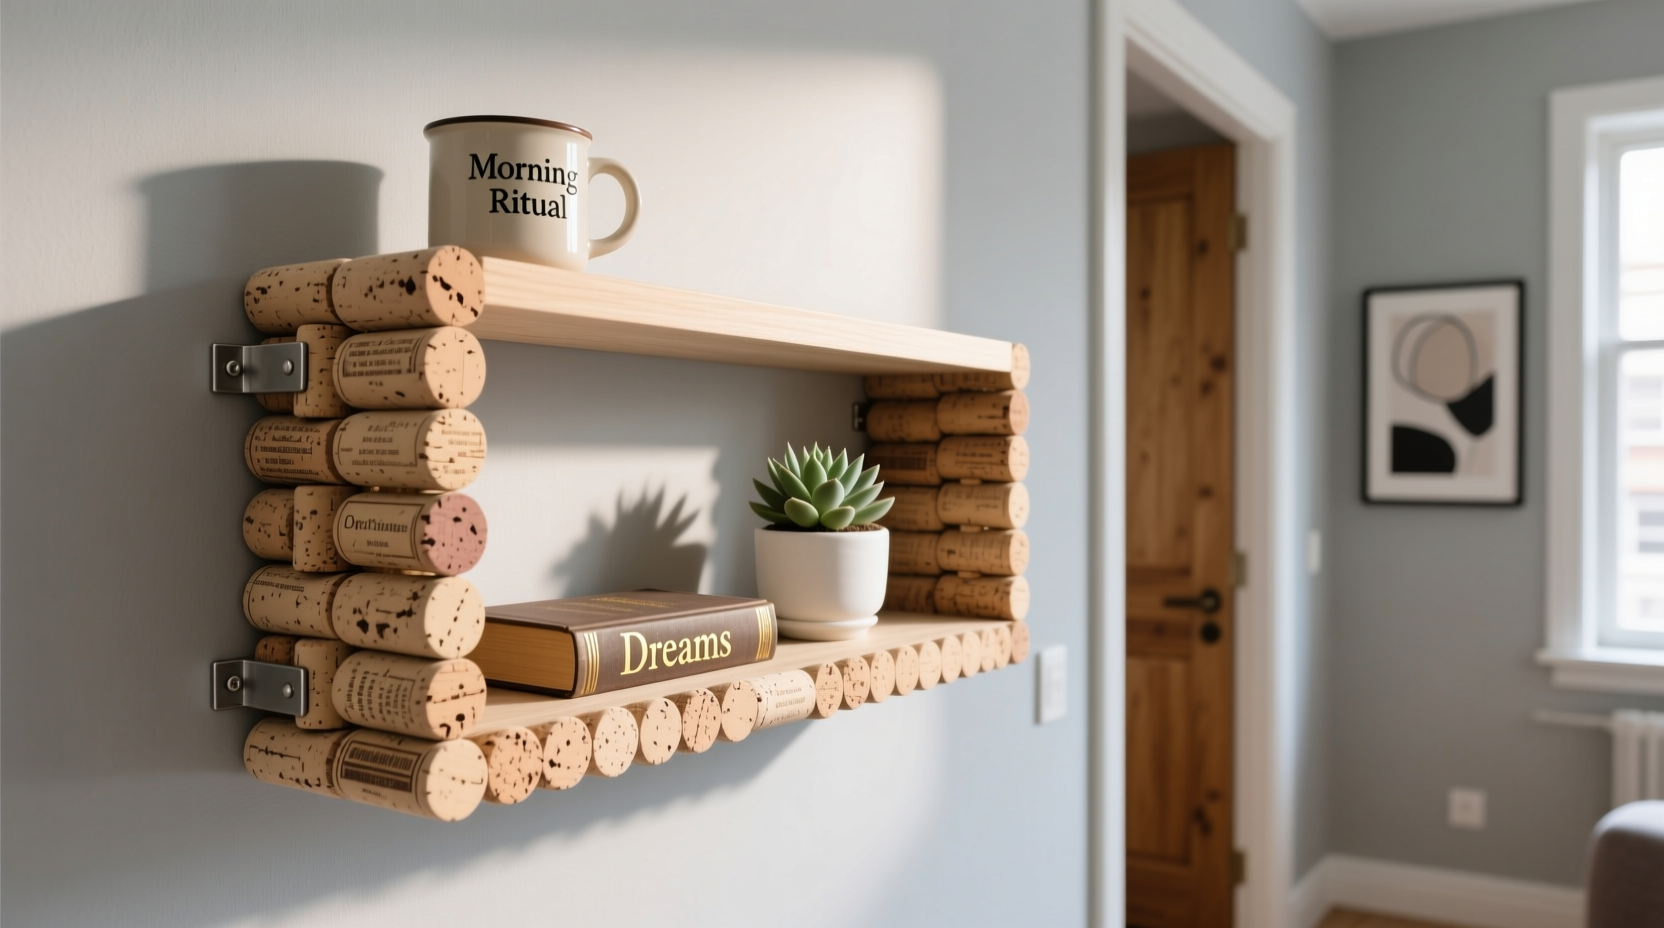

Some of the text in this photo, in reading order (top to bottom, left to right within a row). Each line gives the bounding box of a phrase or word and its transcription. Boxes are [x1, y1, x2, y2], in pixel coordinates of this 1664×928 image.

[468, 153, 578, 195] Morning
[489, 188, 567, 219] Ritual
[620, 630, 732, 676] Dreams
